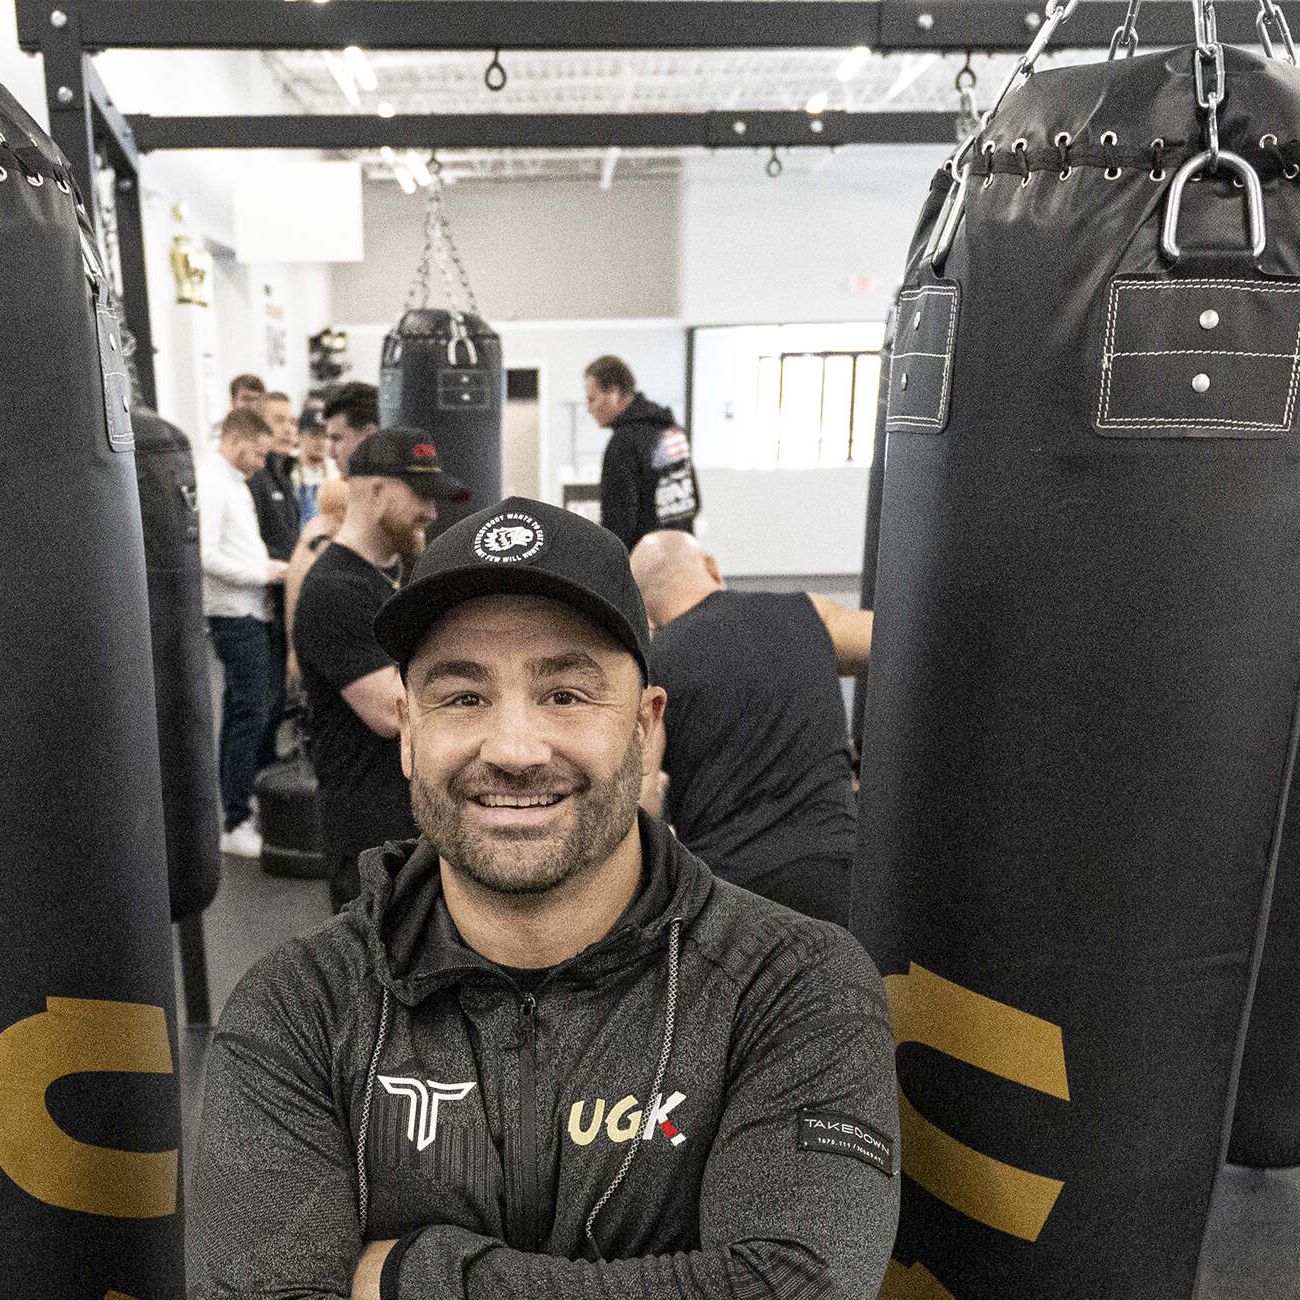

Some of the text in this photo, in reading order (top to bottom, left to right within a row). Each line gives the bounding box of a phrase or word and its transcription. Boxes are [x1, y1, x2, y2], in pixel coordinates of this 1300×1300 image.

[506, 513, 533, 524] WANTS
[531, 521, 541, 530] TO
[485, 554, 501, 562] FEW
[502, 554, 522, 562] WILL
[568, 1091, 687, 1146] UGK
[804, 1118, 890, 1156] TAKEDOWN
